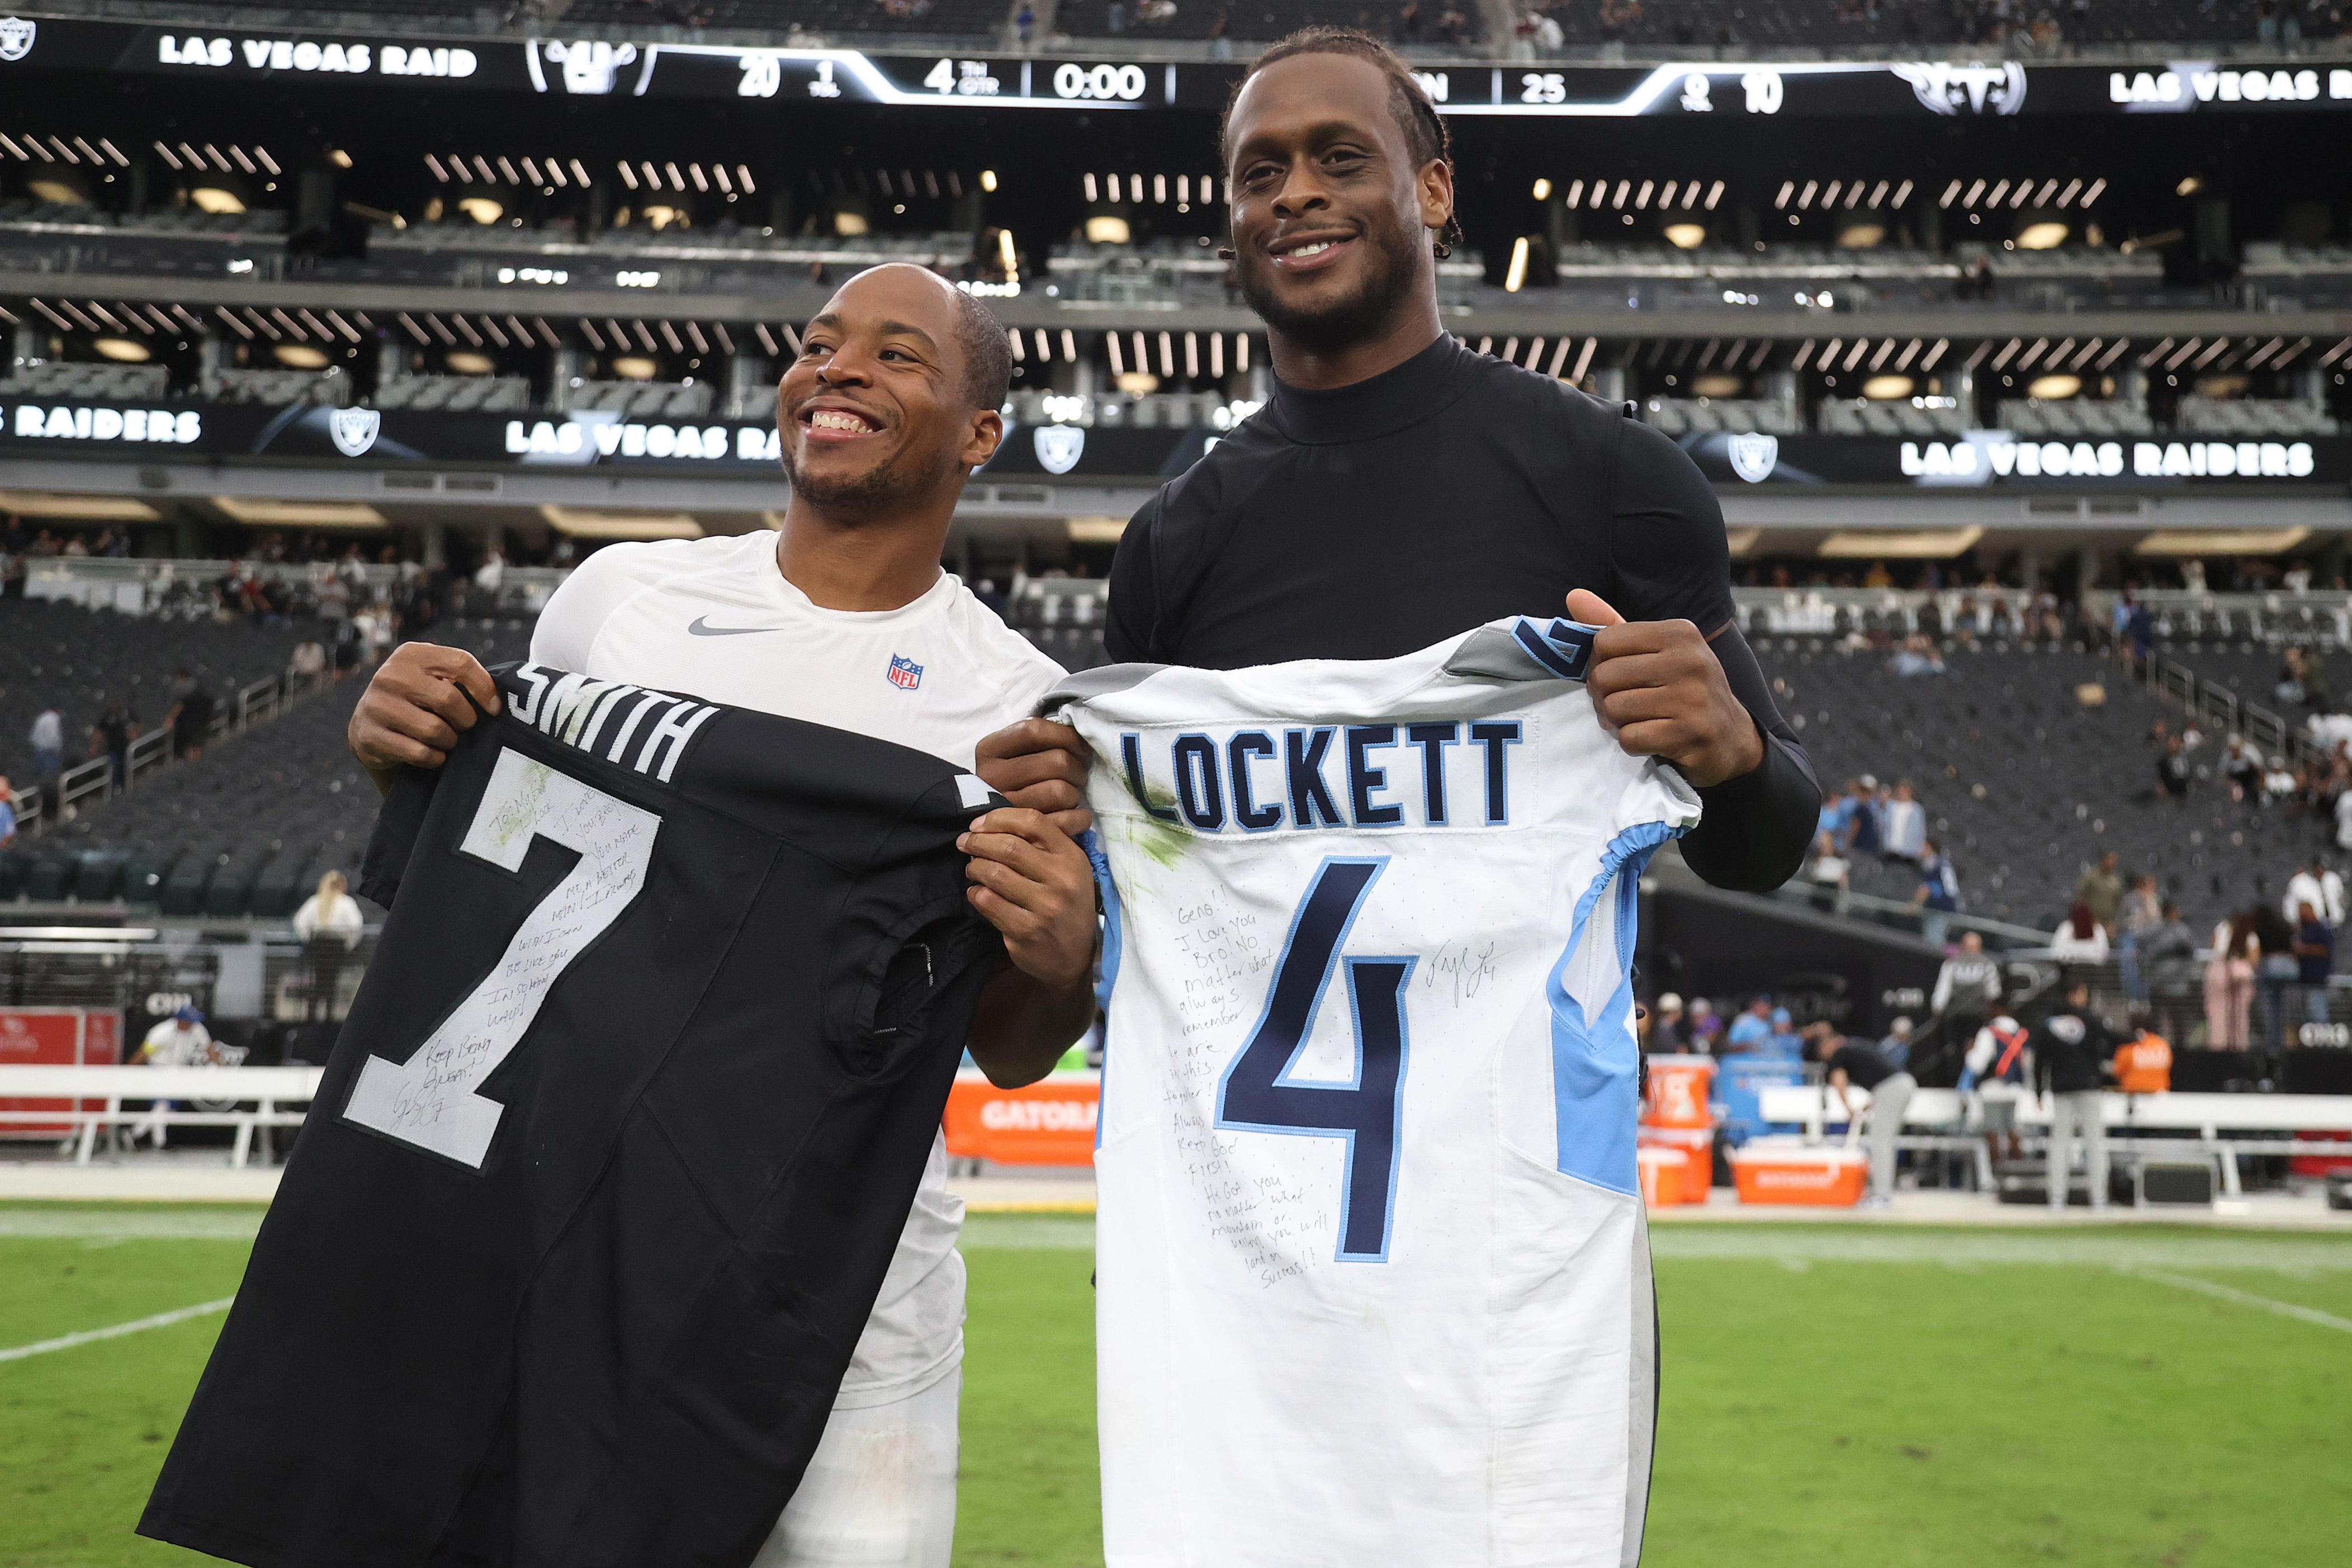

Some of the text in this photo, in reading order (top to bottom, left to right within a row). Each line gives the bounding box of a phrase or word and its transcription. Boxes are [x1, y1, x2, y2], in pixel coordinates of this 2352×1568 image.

[158, 35, 477, 77] LAS VEGAS RAID
[737, 55, 781, 97] 20
[924, 58, 957, 95] 4
[1053, 63, 1147, 101] 0:00
[1521, 72, 1567, 104] 25
[1740, 67, 1783, 115] 10
[2109, 72, 2182, 103] LAS
[2190, 70, 2320, 102] VEGAS
[15, 404, 202, 444] RAIDERS
[505, 420, 583, 455] LAS
[591, 423, 728, 460] VEGAS
[1901, 441, 2316, 478] LAS VEGAS RAIDERS
[889, 666, 916, 687] NFL
[507, 662, 721, 783] SMITH
[1120, 719, 1523, 833] LOCKETT
[342, 746, 664, 1169] 7
[1213, 855, 1421, 1262] 4
